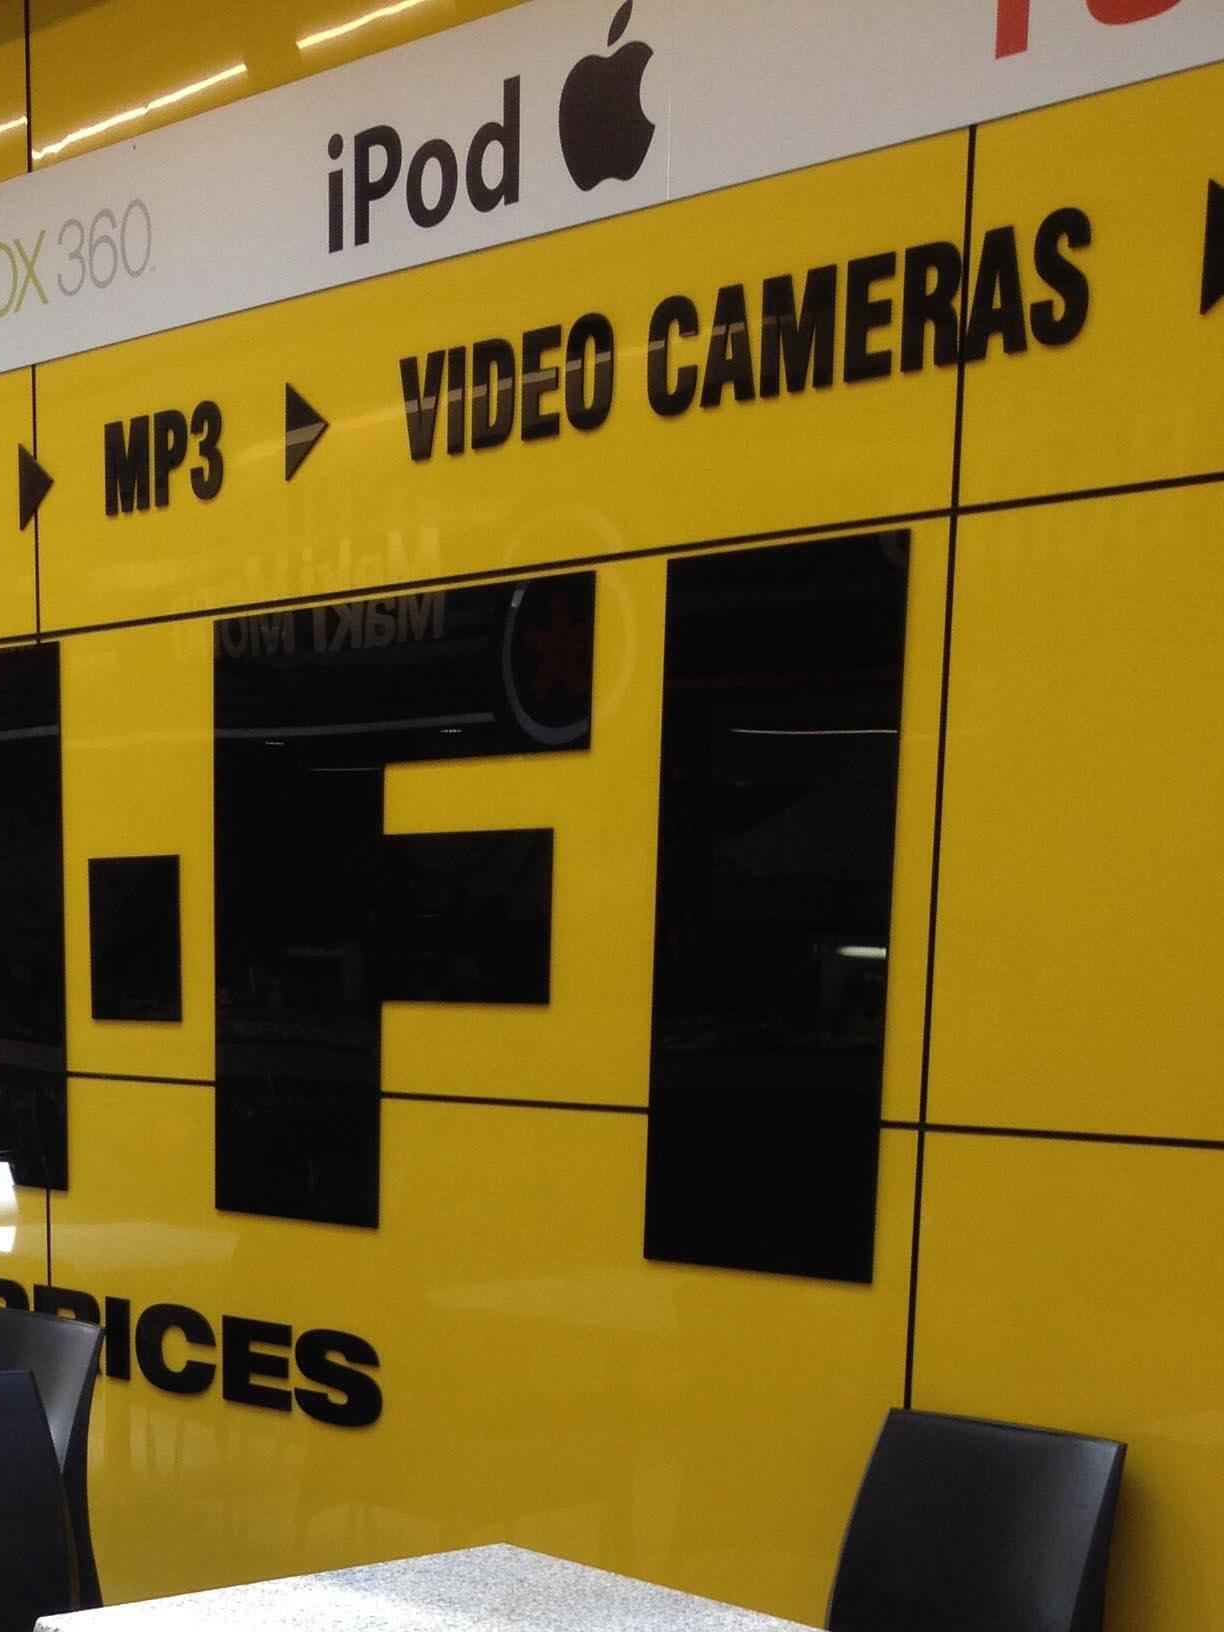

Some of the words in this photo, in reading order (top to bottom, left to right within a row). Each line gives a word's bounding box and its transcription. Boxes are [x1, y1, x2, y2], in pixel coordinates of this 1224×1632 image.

[326, 75, 522, 255] iPod
[57, 200, 153, 297] 360
[400, 312, 615, 462] VIDEO
[648, 207, 1093, 418] CAMERAS
[104, 400, 225, 517] MP3
